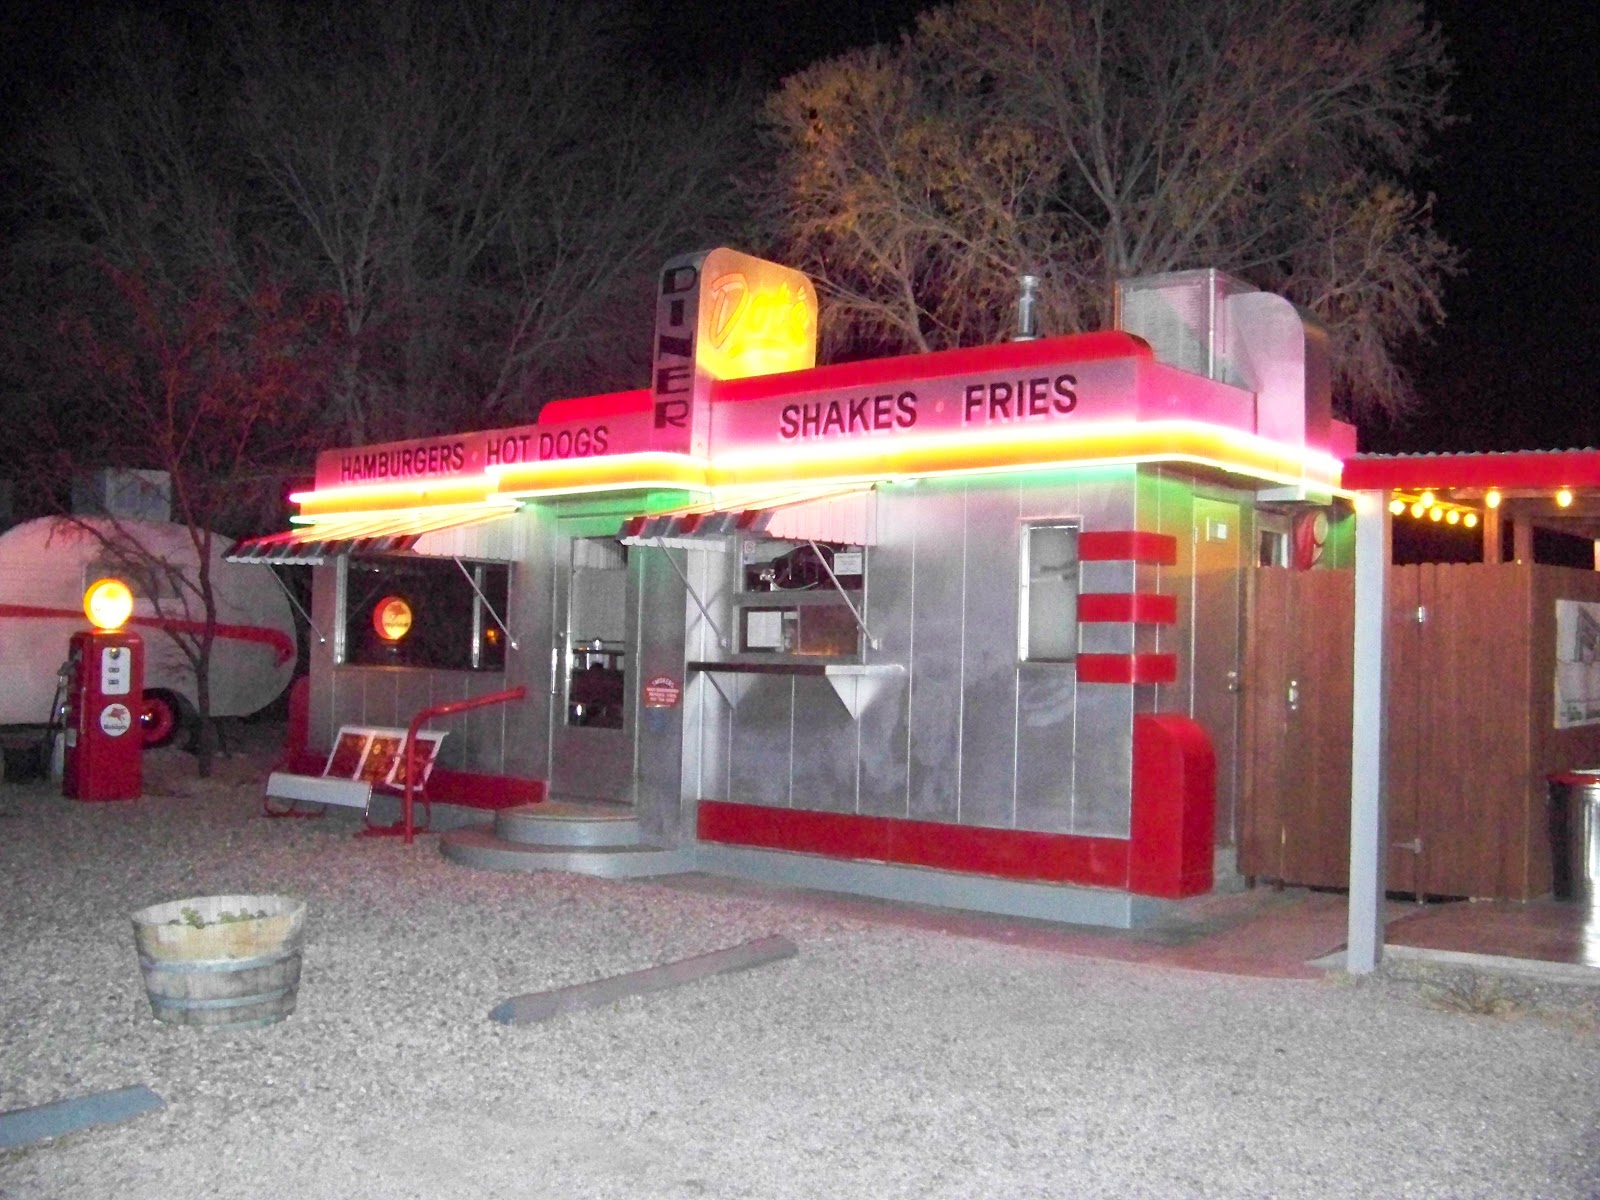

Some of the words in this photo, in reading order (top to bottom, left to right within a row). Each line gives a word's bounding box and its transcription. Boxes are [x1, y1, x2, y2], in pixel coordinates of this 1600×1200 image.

[654, 264, 698, 429] DINER
[780, 391, 918, 439] SHAKES
[965, 374, 1078, 422] FRIES
[341, 442, 465, 482] HAMBURGERS
[486, 435, 531, 465] HOT
[539, 425, 609, 461] DOGS
